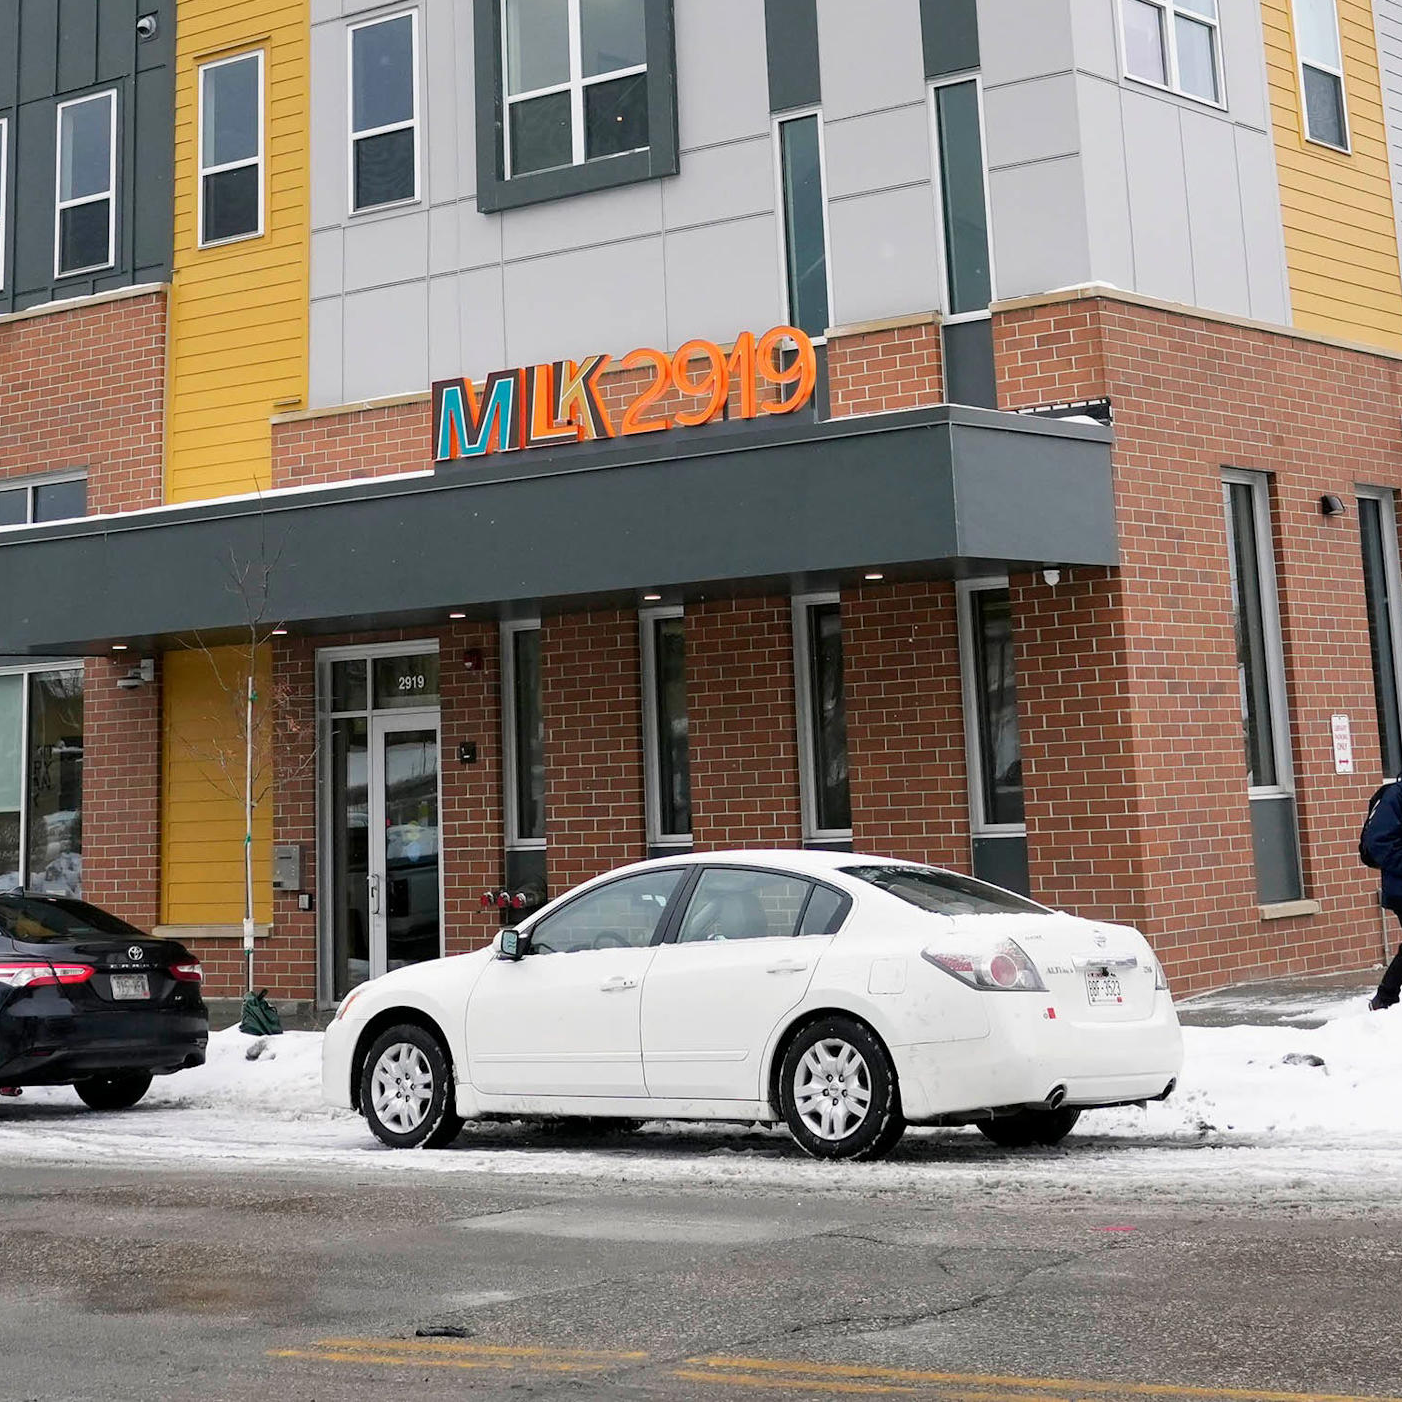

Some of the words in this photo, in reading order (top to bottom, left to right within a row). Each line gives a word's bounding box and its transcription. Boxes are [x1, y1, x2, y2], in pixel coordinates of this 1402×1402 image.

[432, 354, 615, 461] MLK
[621, 325, 817, 436] 2919
[399, 675, 425, 690] 2919
